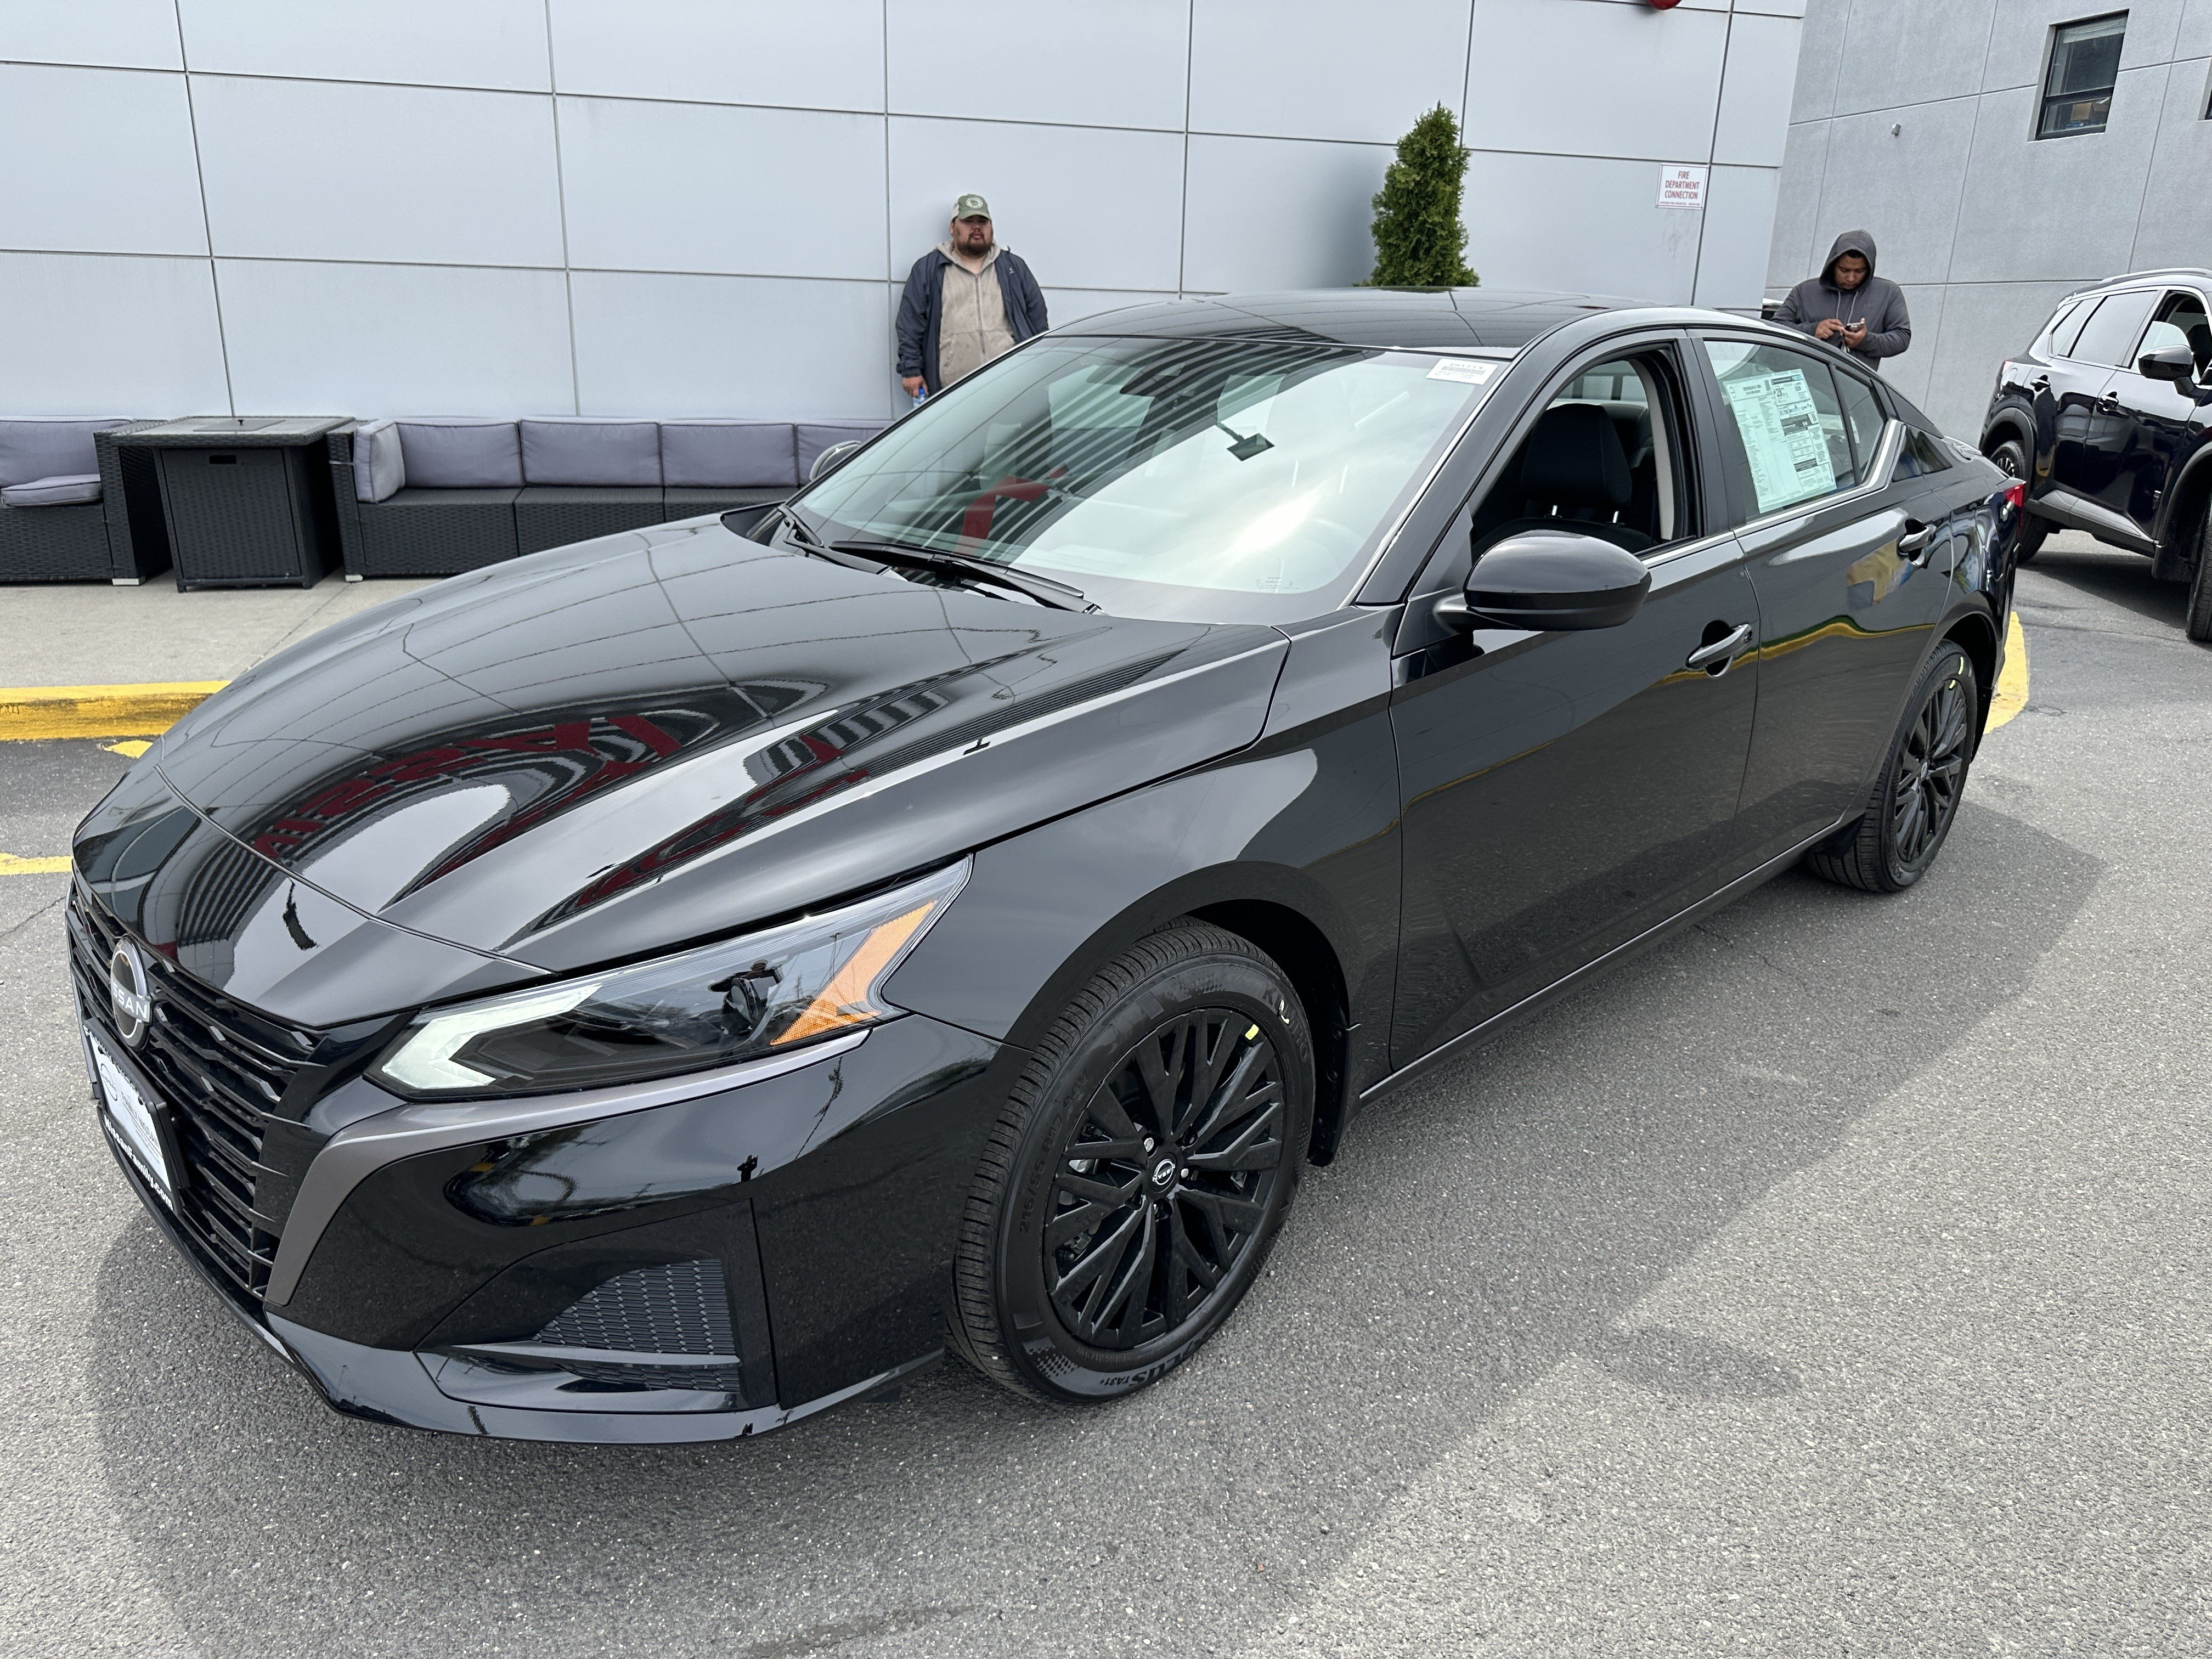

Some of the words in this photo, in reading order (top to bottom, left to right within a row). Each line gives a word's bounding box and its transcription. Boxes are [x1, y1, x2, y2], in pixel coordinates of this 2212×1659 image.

[1678, 171, 1690, 179] FIRE
[1665, 180, 1700, 190] DEPARTMENT
[1664, 190, 1698, 199] CONNECTION
[112, 981, 148, 1019] SSAN
[1041, 1112, 1063, 1154] R17
[104, 1114, 174, 1211] NissanFamily.com
[1099, 1375, 1131, 1387] TA31+
